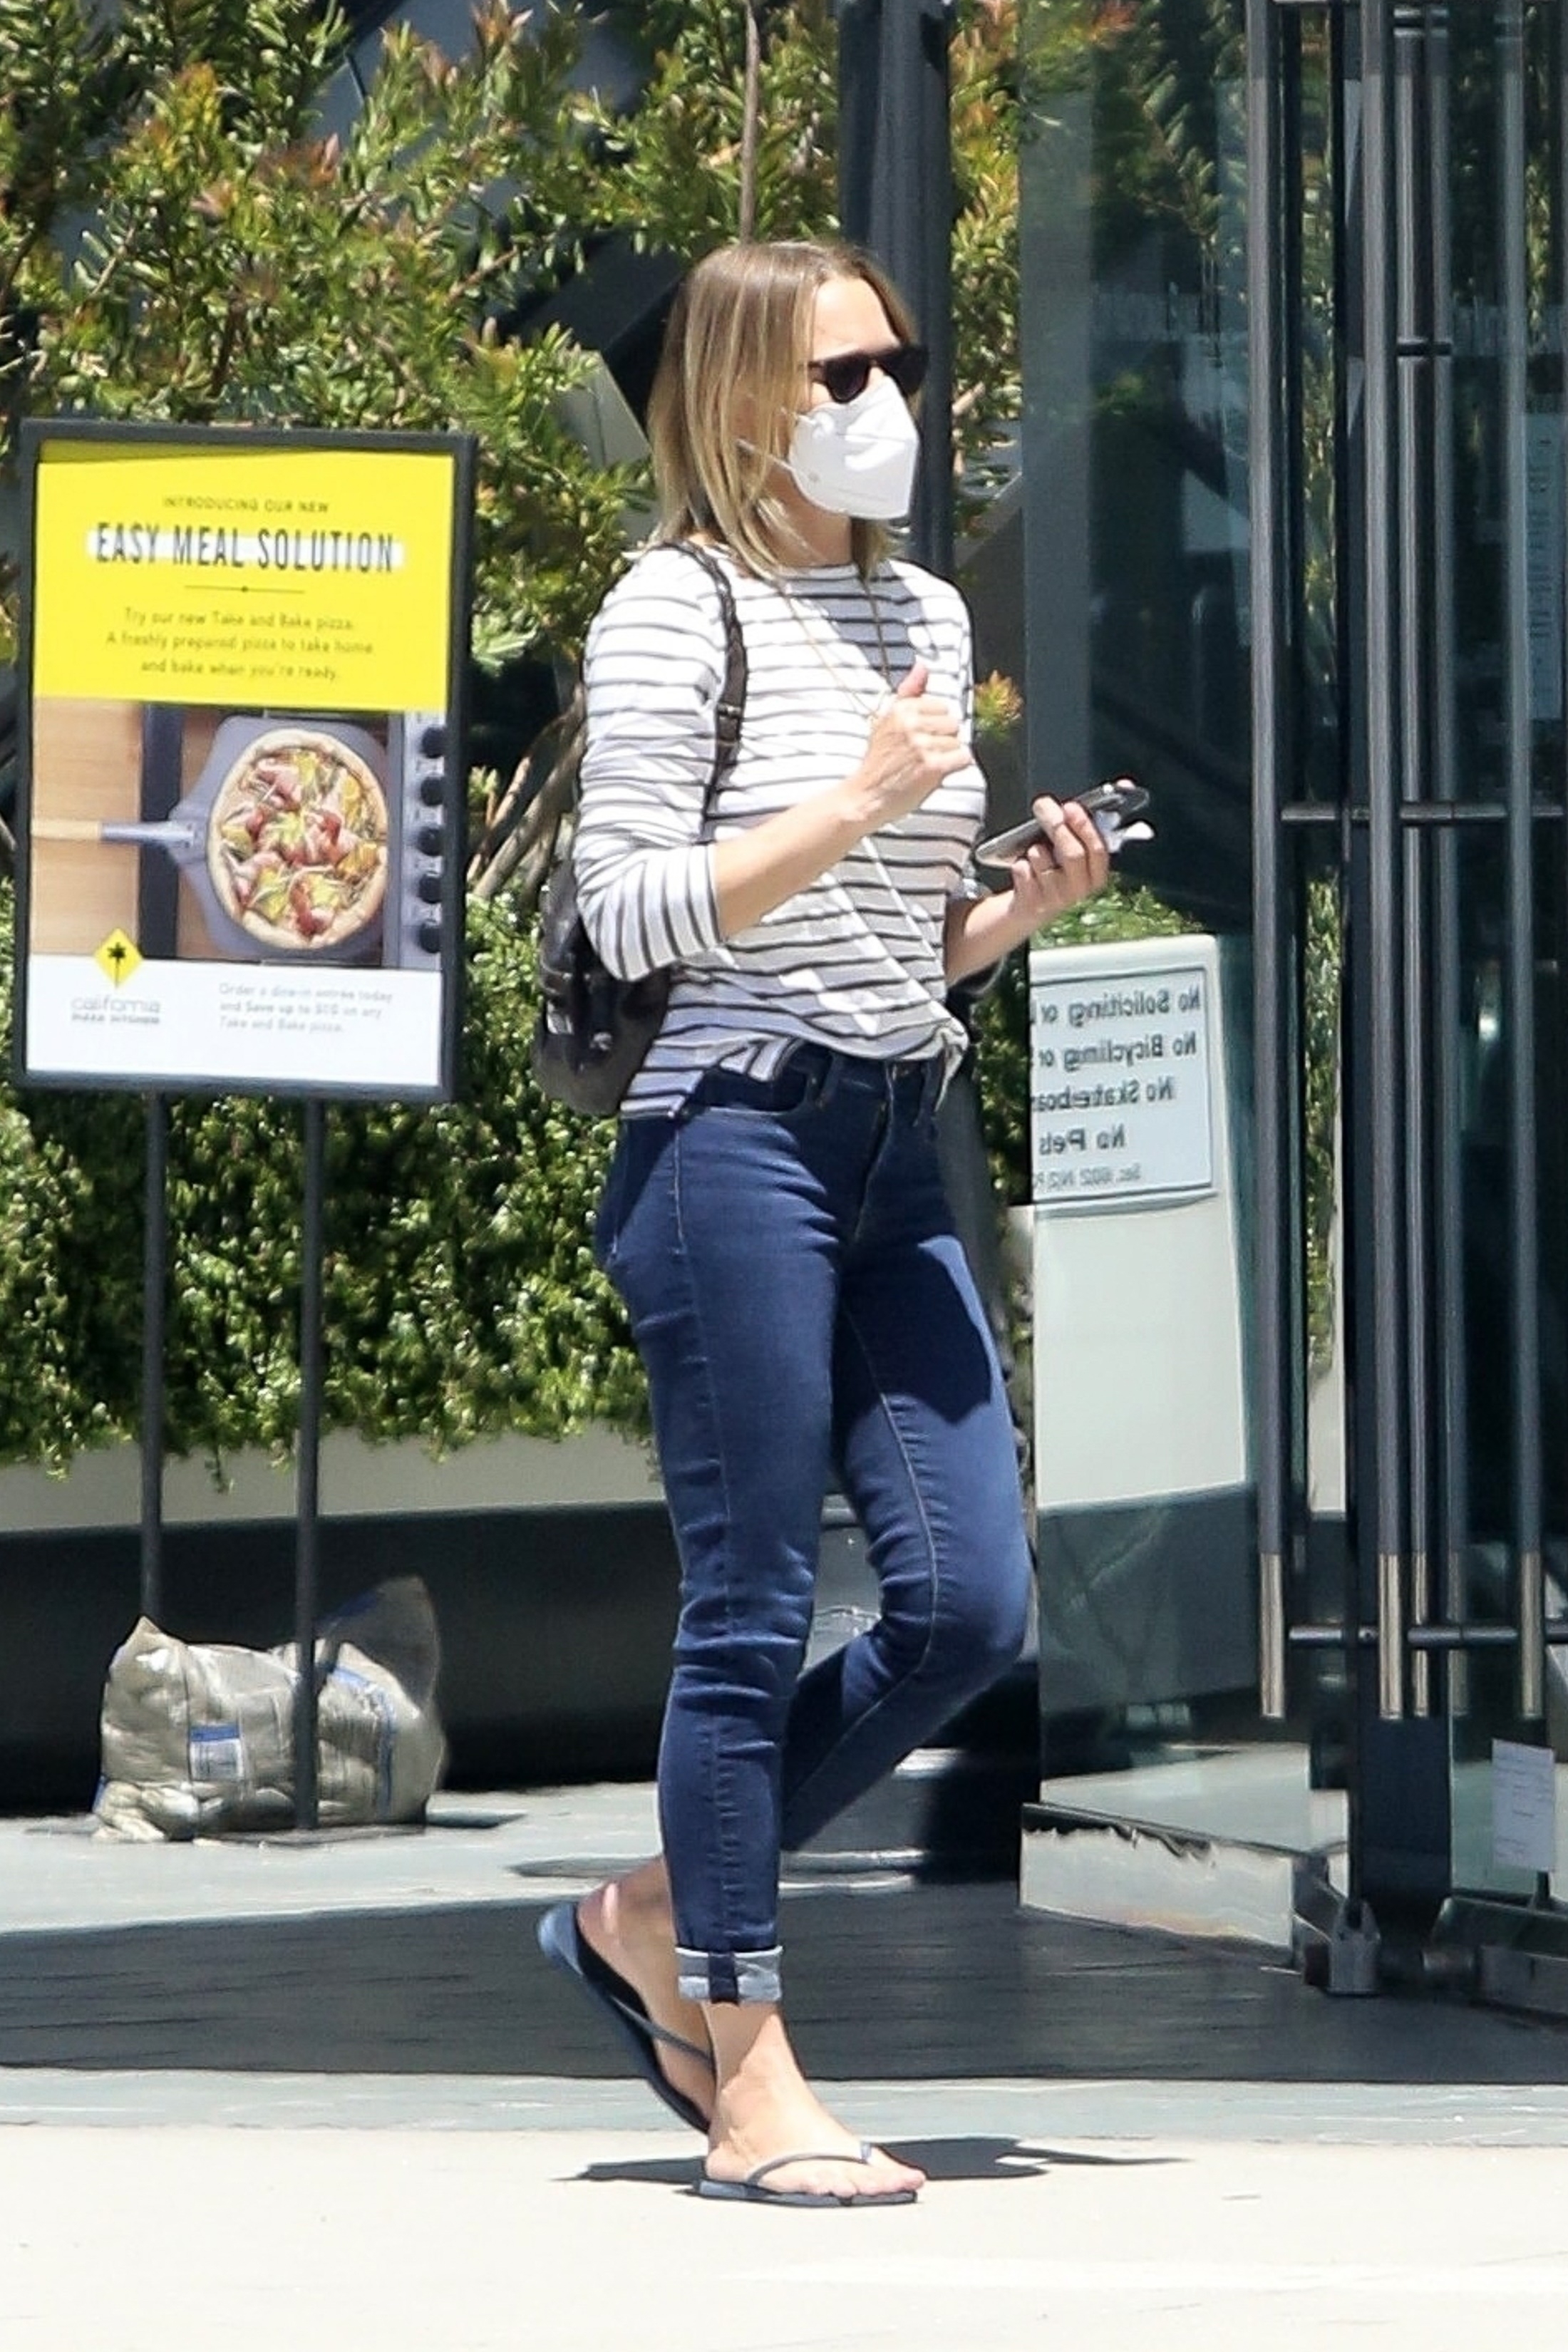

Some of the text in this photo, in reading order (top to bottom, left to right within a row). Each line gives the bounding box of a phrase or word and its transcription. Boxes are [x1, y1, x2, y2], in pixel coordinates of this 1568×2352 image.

[164, 497, 329, 513] INTRODUCING OUR NEW
[96, 522, 393, 573] EASY MEAL SOLUTION
[249, 612, 275, 627] and
[107, 631, 115, 642] A
[281, 638, 296, 650] to
[141, 659, 166, 672] and
[71, 994, 160, 1013] california
